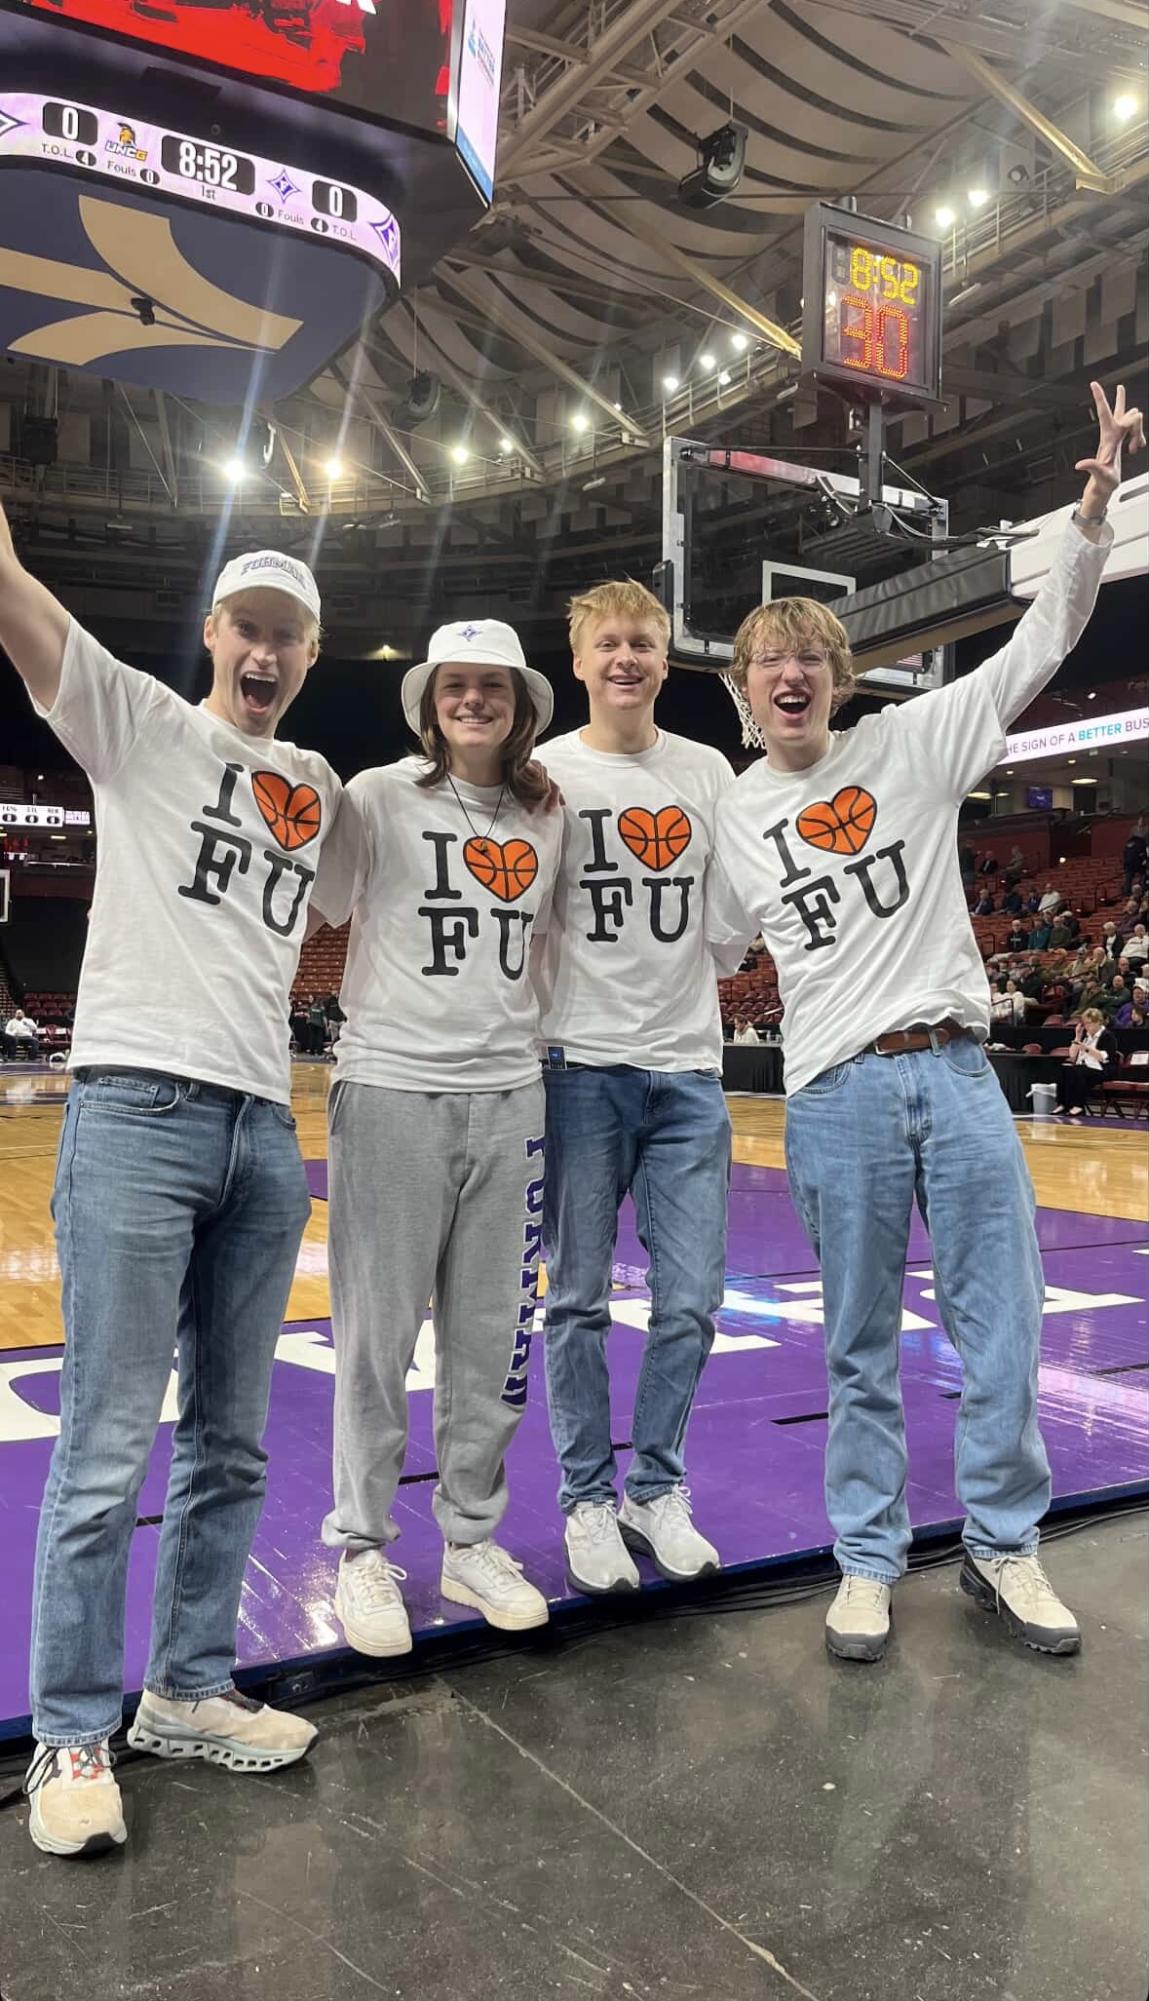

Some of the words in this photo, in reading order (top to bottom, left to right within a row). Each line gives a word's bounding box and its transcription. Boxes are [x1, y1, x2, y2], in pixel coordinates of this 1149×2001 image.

[62, 107, 79, 140] 0
[104, 139, 149, 162] UNCG
[107, 160, 137, 178] Fouls
[178, 140, 238, 191] 8:52
[277, 208, 305, 226] Fouls
[328, 185, 343, 217] 0
[851, 247, 920, 305] 8:52
[840, 294, 909, 380] 30
[1021, 736, 1047, 752] SIGN
[1049, 733, 1065, 747] OF
[1067, 731, 1076, 743] A
[1078, 722, 1123, 742] BETTER
[202, 762, 244, 828] I
[422, 831, 462, 900] I
[578, 808, 619, 873] I
[762, 818, 812, 888] I
